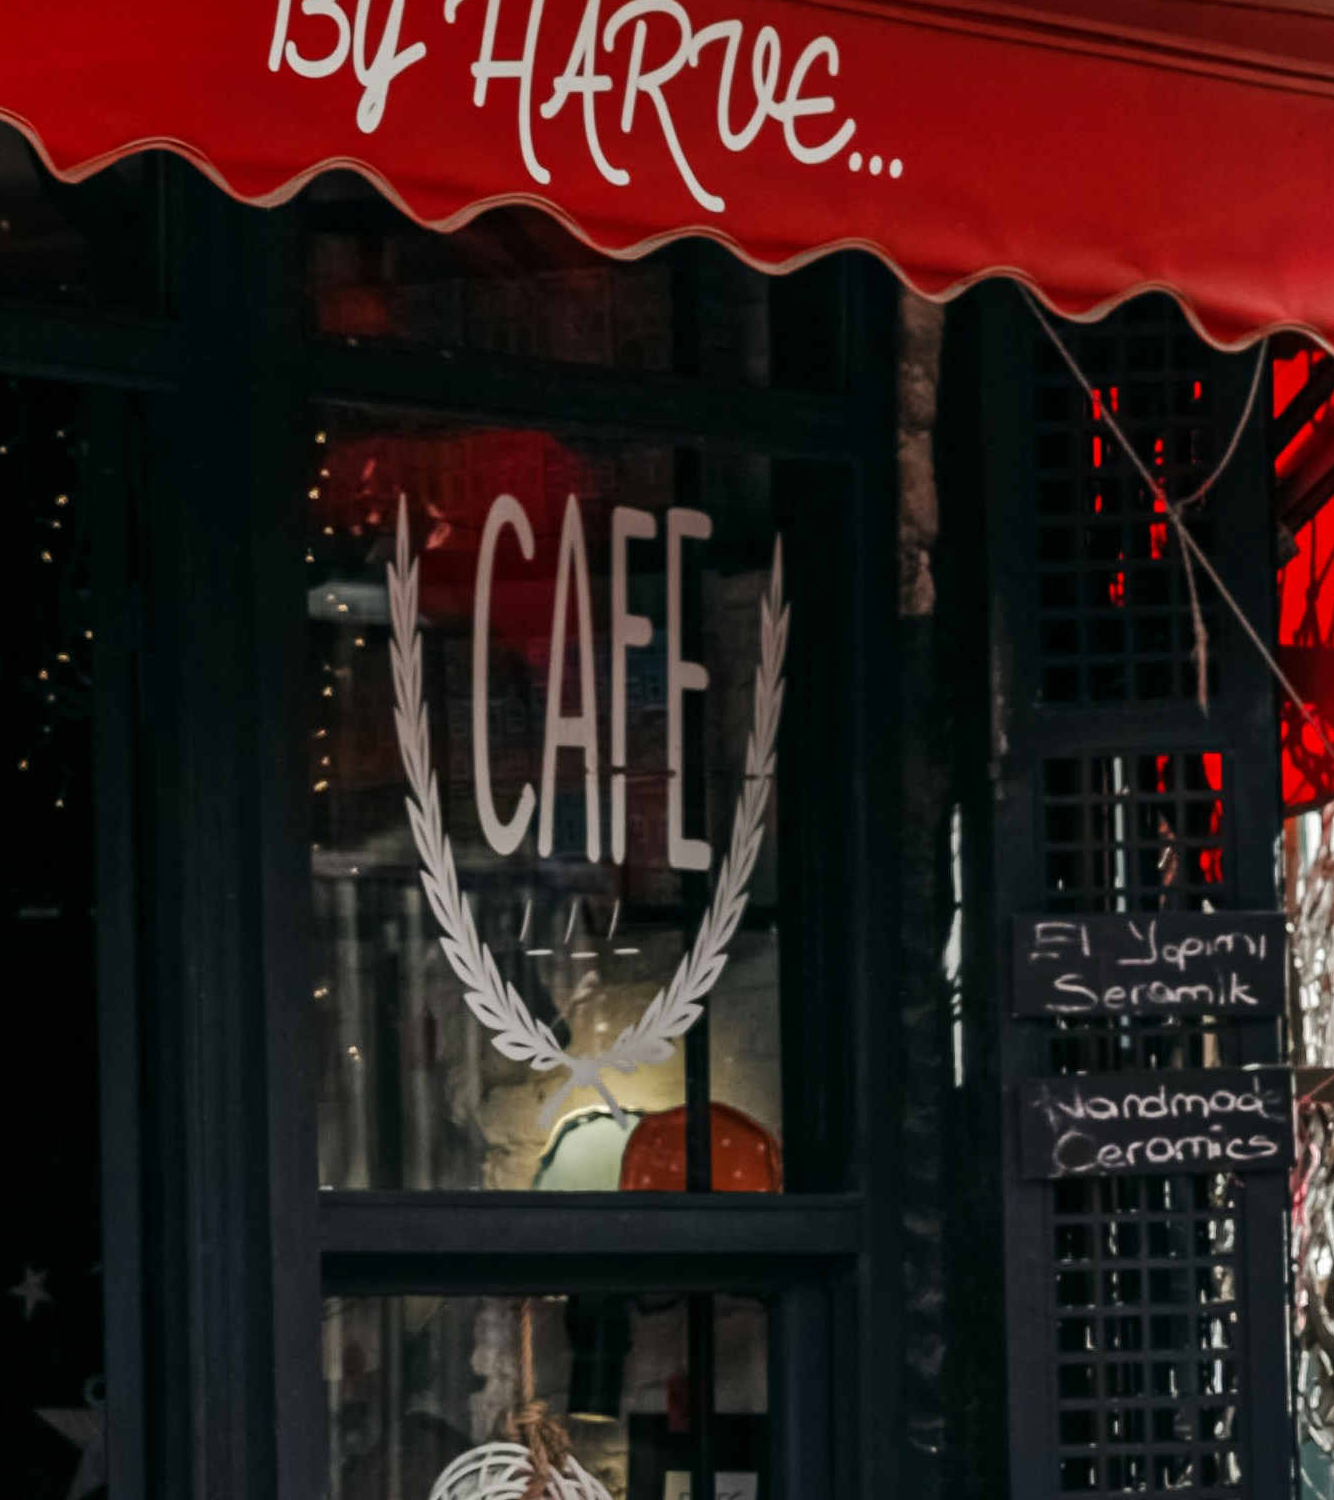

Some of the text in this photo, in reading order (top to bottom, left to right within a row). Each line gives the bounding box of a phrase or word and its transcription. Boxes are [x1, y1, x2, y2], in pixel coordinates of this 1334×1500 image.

[472, 493, 713, 870] CAFE
[1030, 921, 1091, 960] El
[1047, 1125, 1278, 1178] Ceramics
